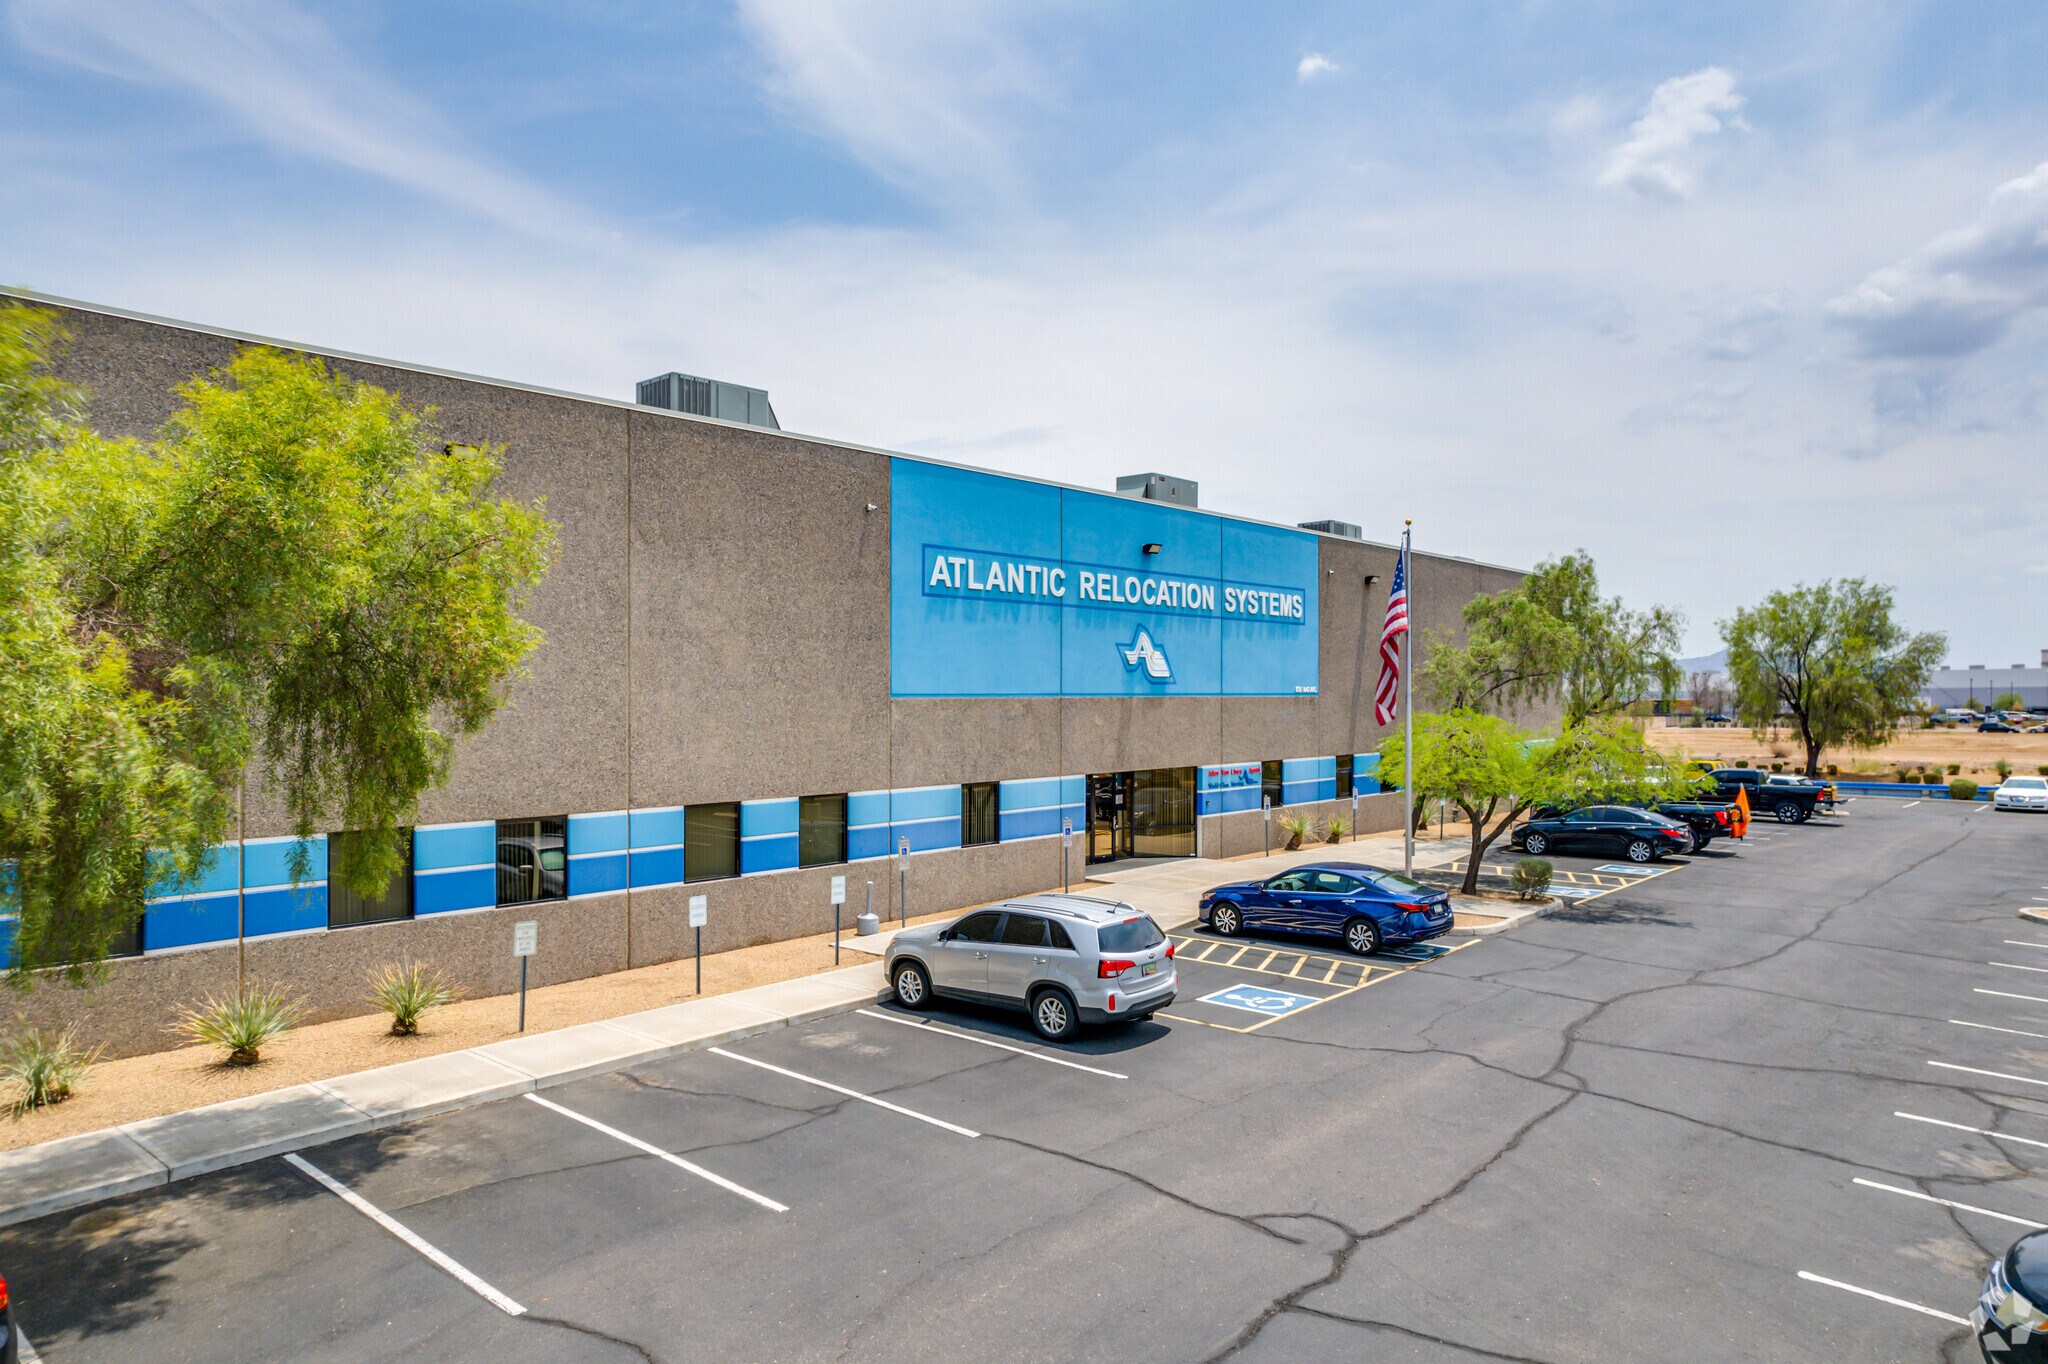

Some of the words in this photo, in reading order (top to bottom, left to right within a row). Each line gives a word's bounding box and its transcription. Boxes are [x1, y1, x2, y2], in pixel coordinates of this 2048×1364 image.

[929, 555, 1066, 597] ATLANTIC
[1079, 571, 1215, 610] RELOCATION
[1224, 587, 1303, 618] SYSTEMS
